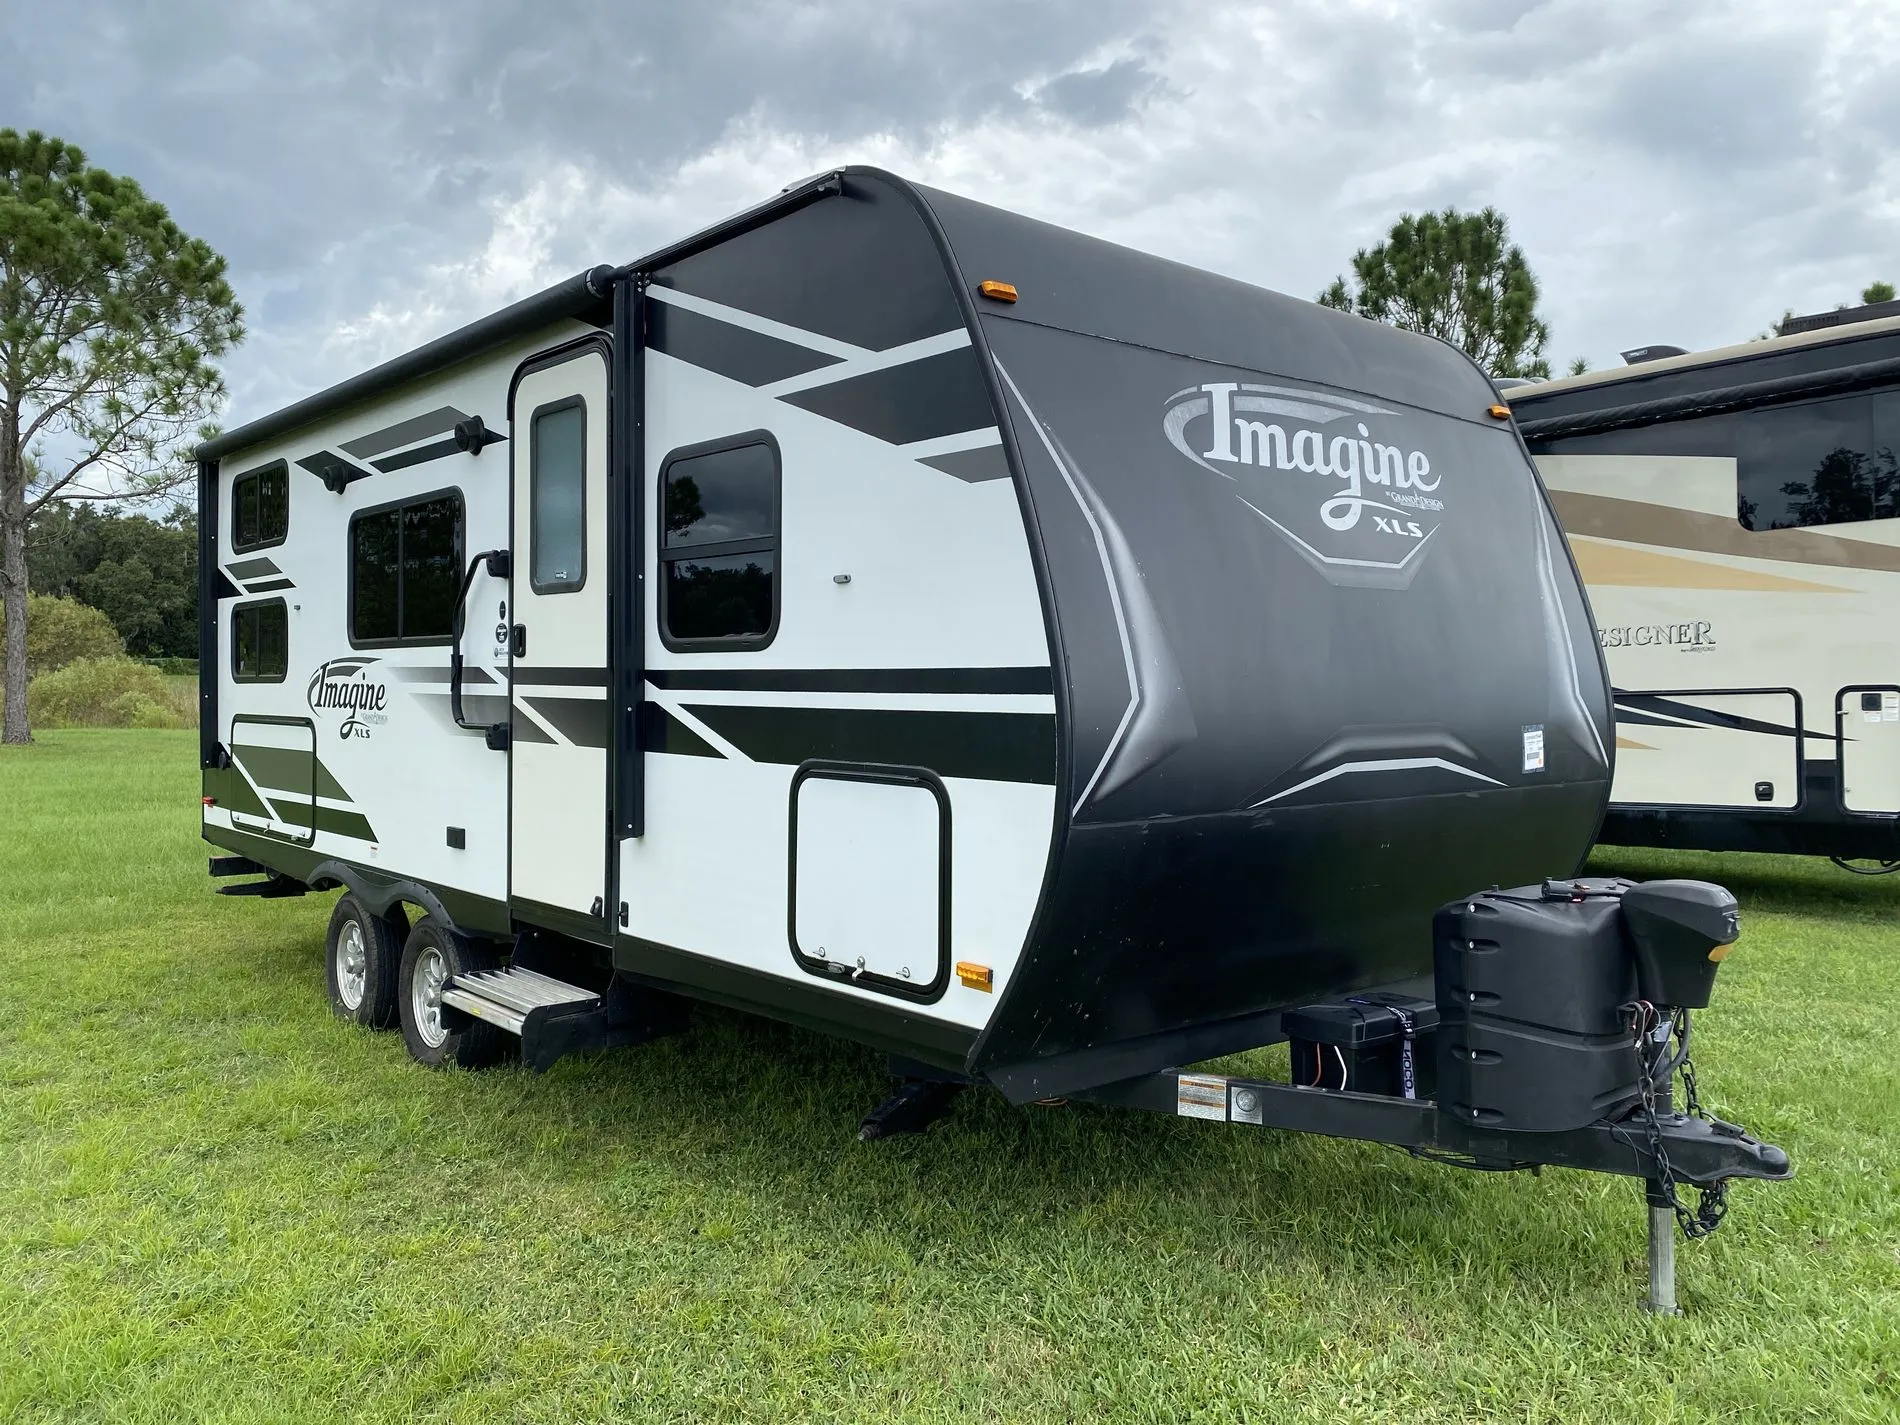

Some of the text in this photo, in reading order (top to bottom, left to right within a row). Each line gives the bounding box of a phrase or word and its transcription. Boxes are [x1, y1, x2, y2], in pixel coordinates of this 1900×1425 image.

[1202, 382, 1441, 531] Imagine
[1372, 516, 1423, 538] XLS
[1597, 619, 1716, 648] ESIGNER
[314, 661, 388, 740] Imagine
[353, 727, 371, 739] XLS
